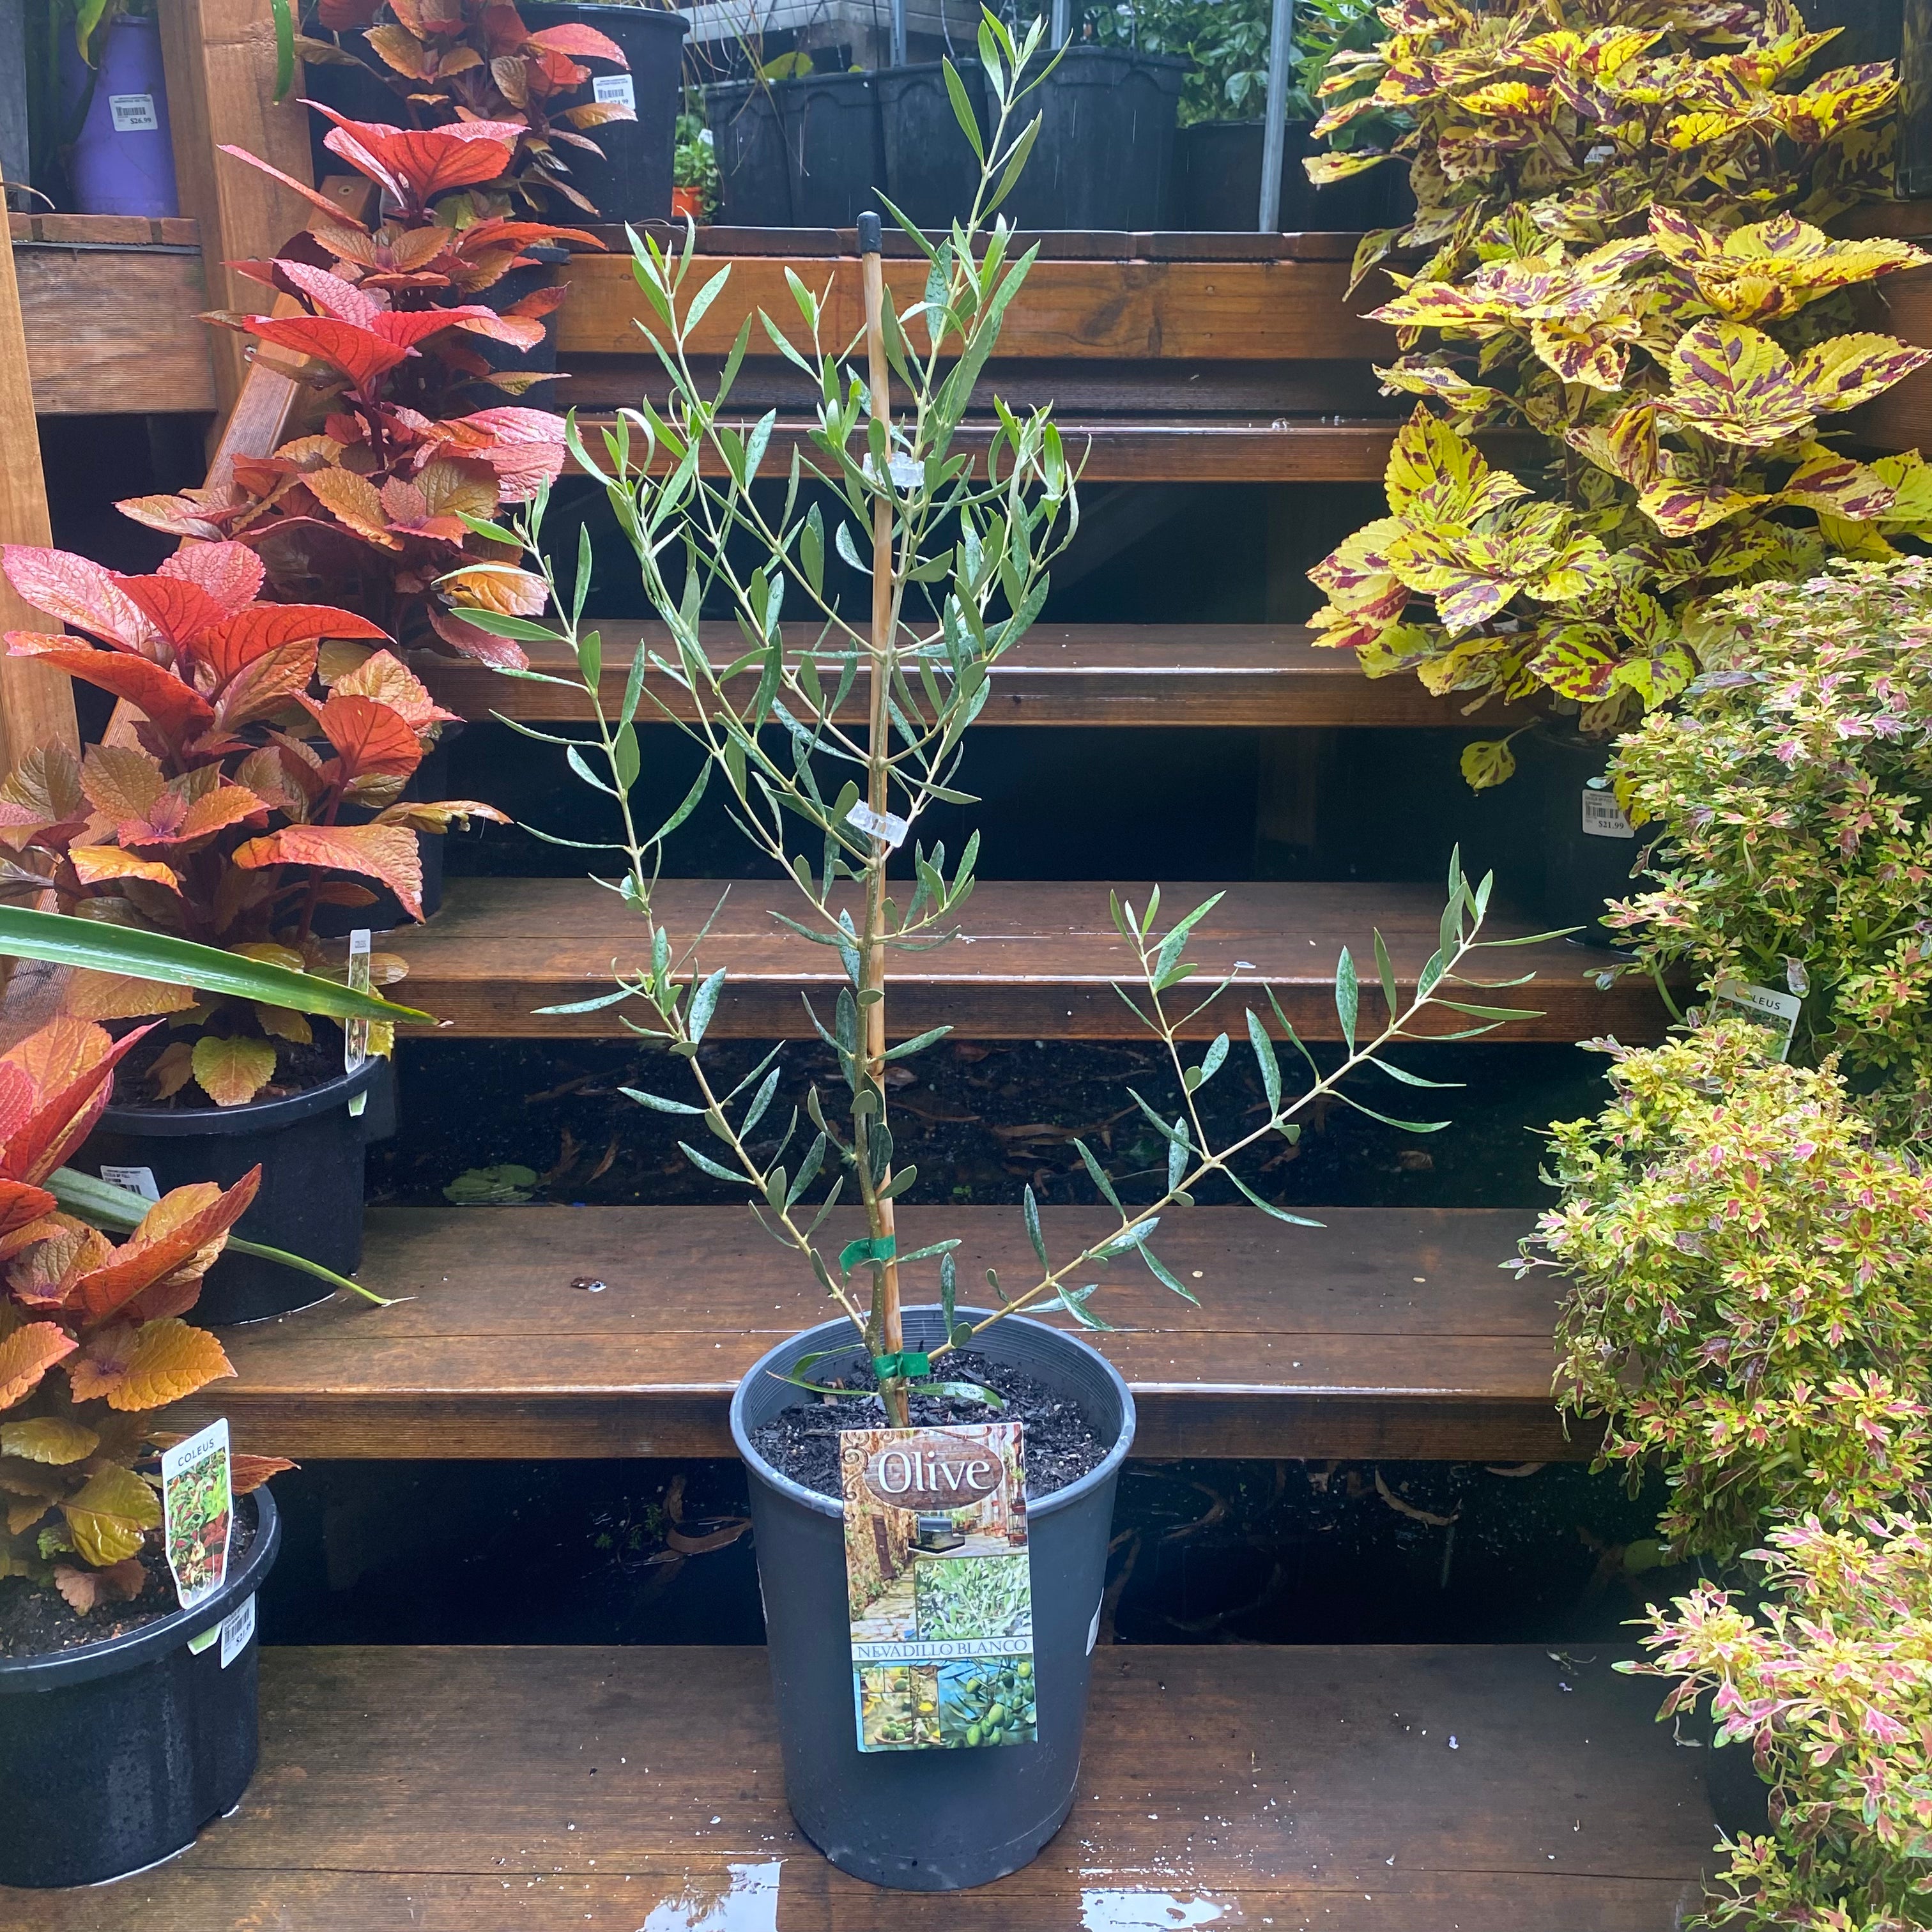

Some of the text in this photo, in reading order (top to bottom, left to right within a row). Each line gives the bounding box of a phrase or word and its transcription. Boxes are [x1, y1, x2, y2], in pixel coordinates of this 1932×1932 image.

[1598, 820, 1624, 829] $21.99
[1752, 995, 1781, 1010] LEUS
[178, 1438, 215, 1466] COLEUS
[878, 1451, 992, 1494] Olive
[857, 1639, 1027, 1658] NEVADILLO BLANCO
